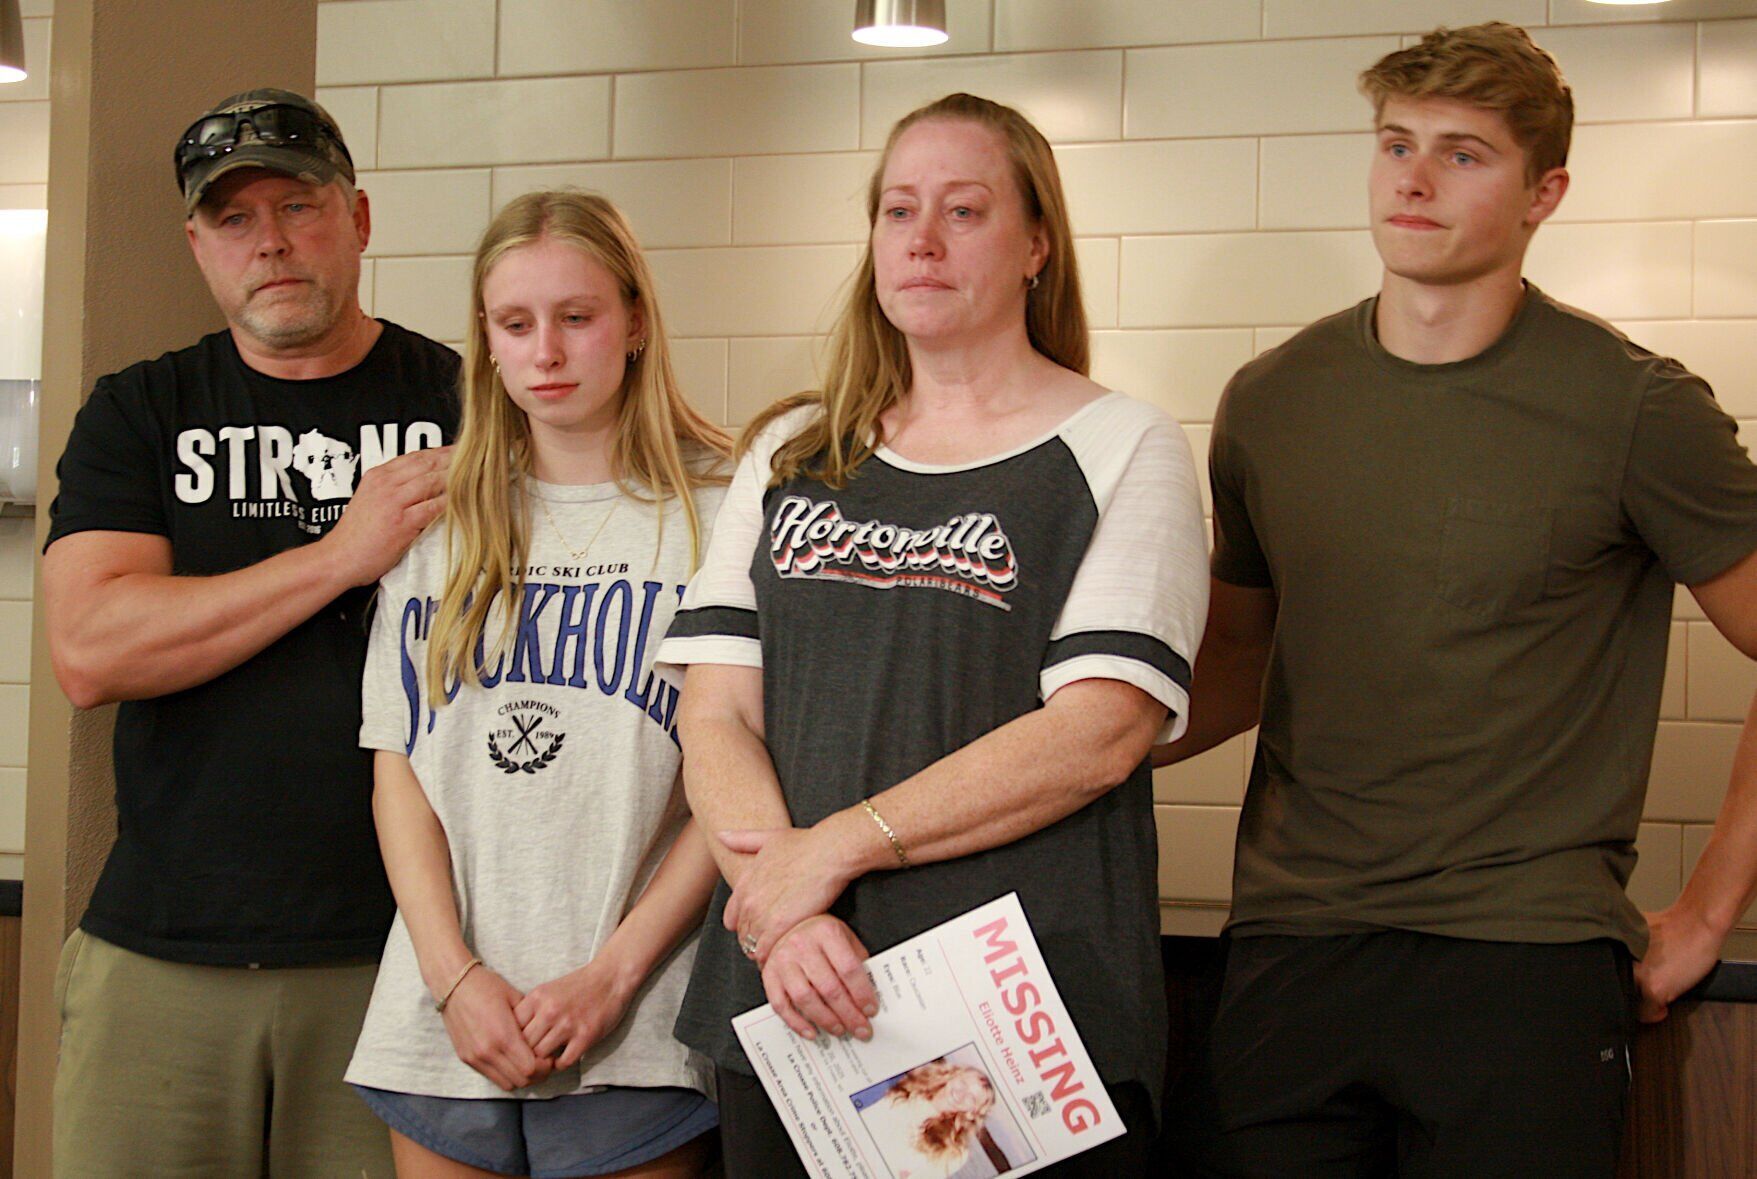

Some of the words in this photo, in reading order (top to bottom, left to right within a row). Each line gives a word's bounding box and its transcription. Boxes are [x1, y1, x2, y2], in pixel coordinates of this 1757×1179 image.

[232, 501, 305, 520] LIMITLESS
[770, 496, 1018, 593] Hortonville
[552, 566, 580, 578] SKI
[586, 563, 629, 577] CLUB
[498, 700, 561, 719] CHAMPIONS
[497, 729, 515, 739] EST.
[973, 917, 1101, 1135] MISSING
[977, 1001, 1006, 1044] Eliotte
[1001, 1047, 1025, 1084] Heinz
